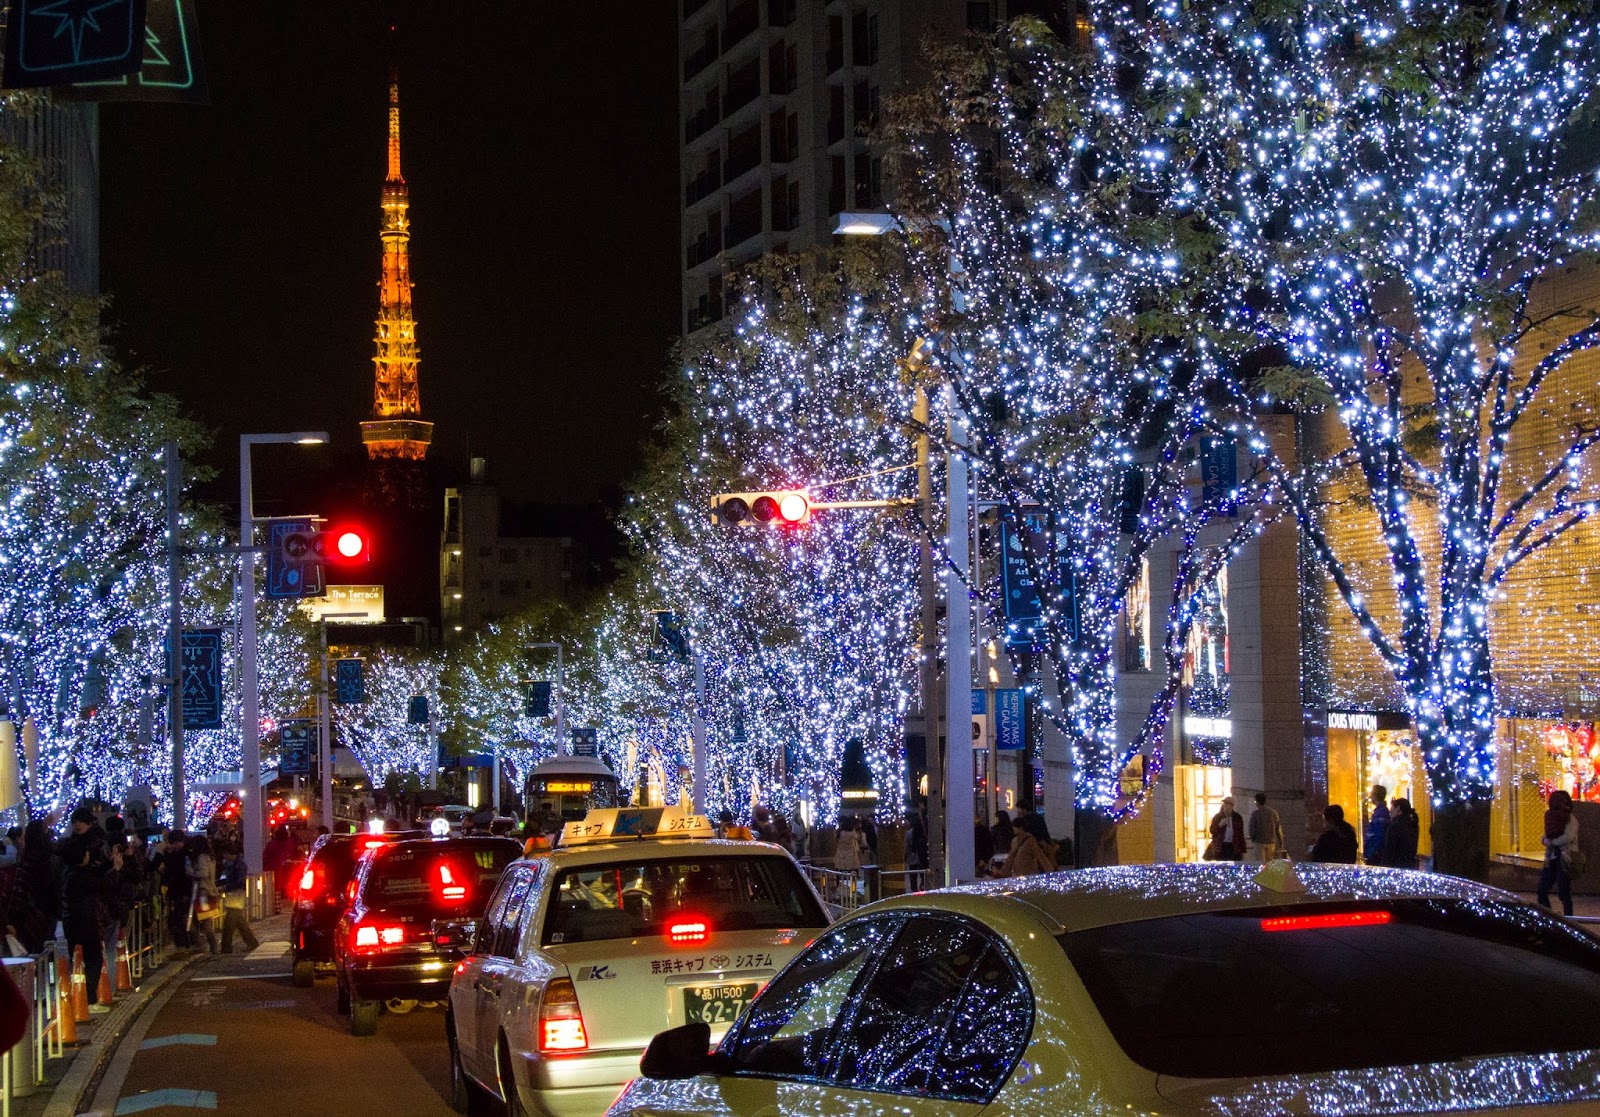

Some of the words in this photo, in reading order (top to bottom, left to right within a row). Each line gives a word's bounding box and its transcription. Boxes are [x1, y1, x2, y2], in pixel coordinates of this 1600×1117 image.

[1208, 466, 1220, 503] GALAX
[332, 590, 346, 599] The
[348, 590, 379, 599] Terrace
[1010, 691, 1019, 719] MERRY
[1001, 709, 1011, 744] GALAXY
[1328, 712, 1348, 729] LOUIS
[1348, 713, 1378, 731] VUITTON
[571, 821, 604, 836] キャブ
[670, 816, 702, 831] システム
[655, 864, 701, 875] 1120
[650, 956, 705, 975] 京浜キャブ
[735, 953, 773, 968] システム
[701, 986, 743, 1001] 品川500
[701, 998, 753, 1023] 62-7
